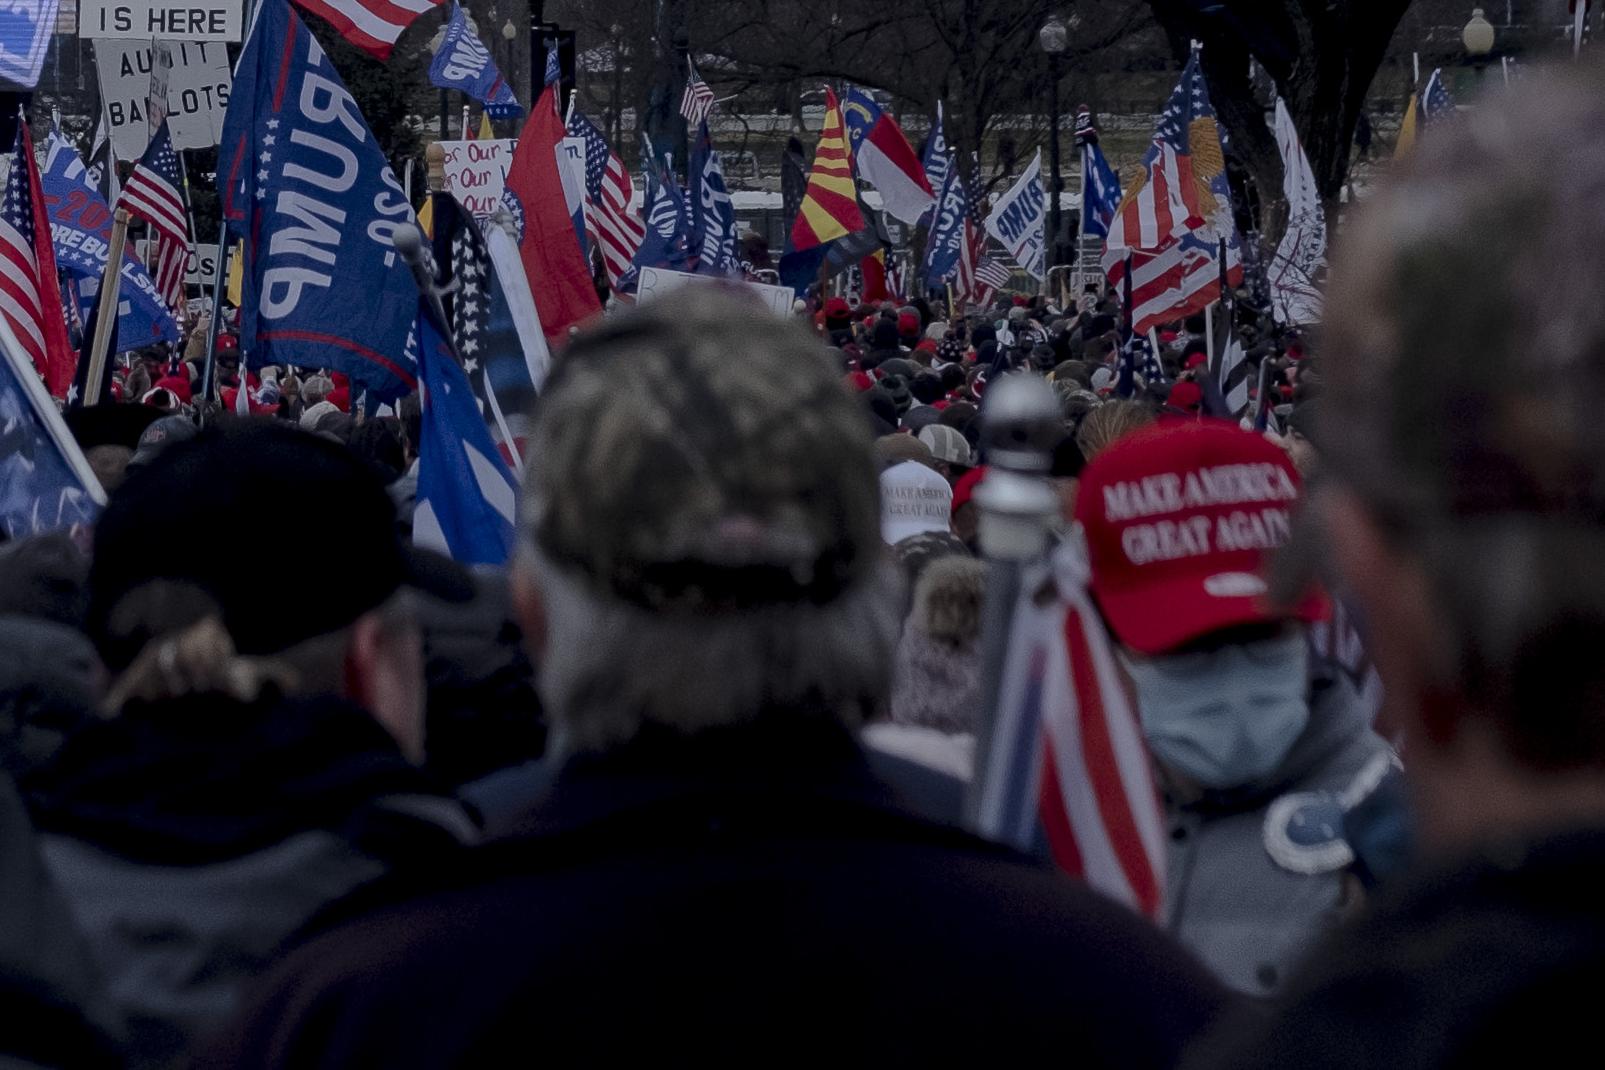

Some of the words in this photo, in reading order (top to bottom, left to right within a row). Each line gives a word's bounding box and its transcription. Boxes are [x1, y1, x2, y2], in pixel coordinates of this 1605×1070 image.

[100, 7, 132, 31] IS
[148, 8, 226, 34] HERE
[468, 143, 501, 163] Our
[461, 167, 492, 188] Our
[1102, 472, 1184, 524] MAKE
[1184, 462, 1296, 509] AMERICA
[1121, 515, 1213, 566] GREAT
